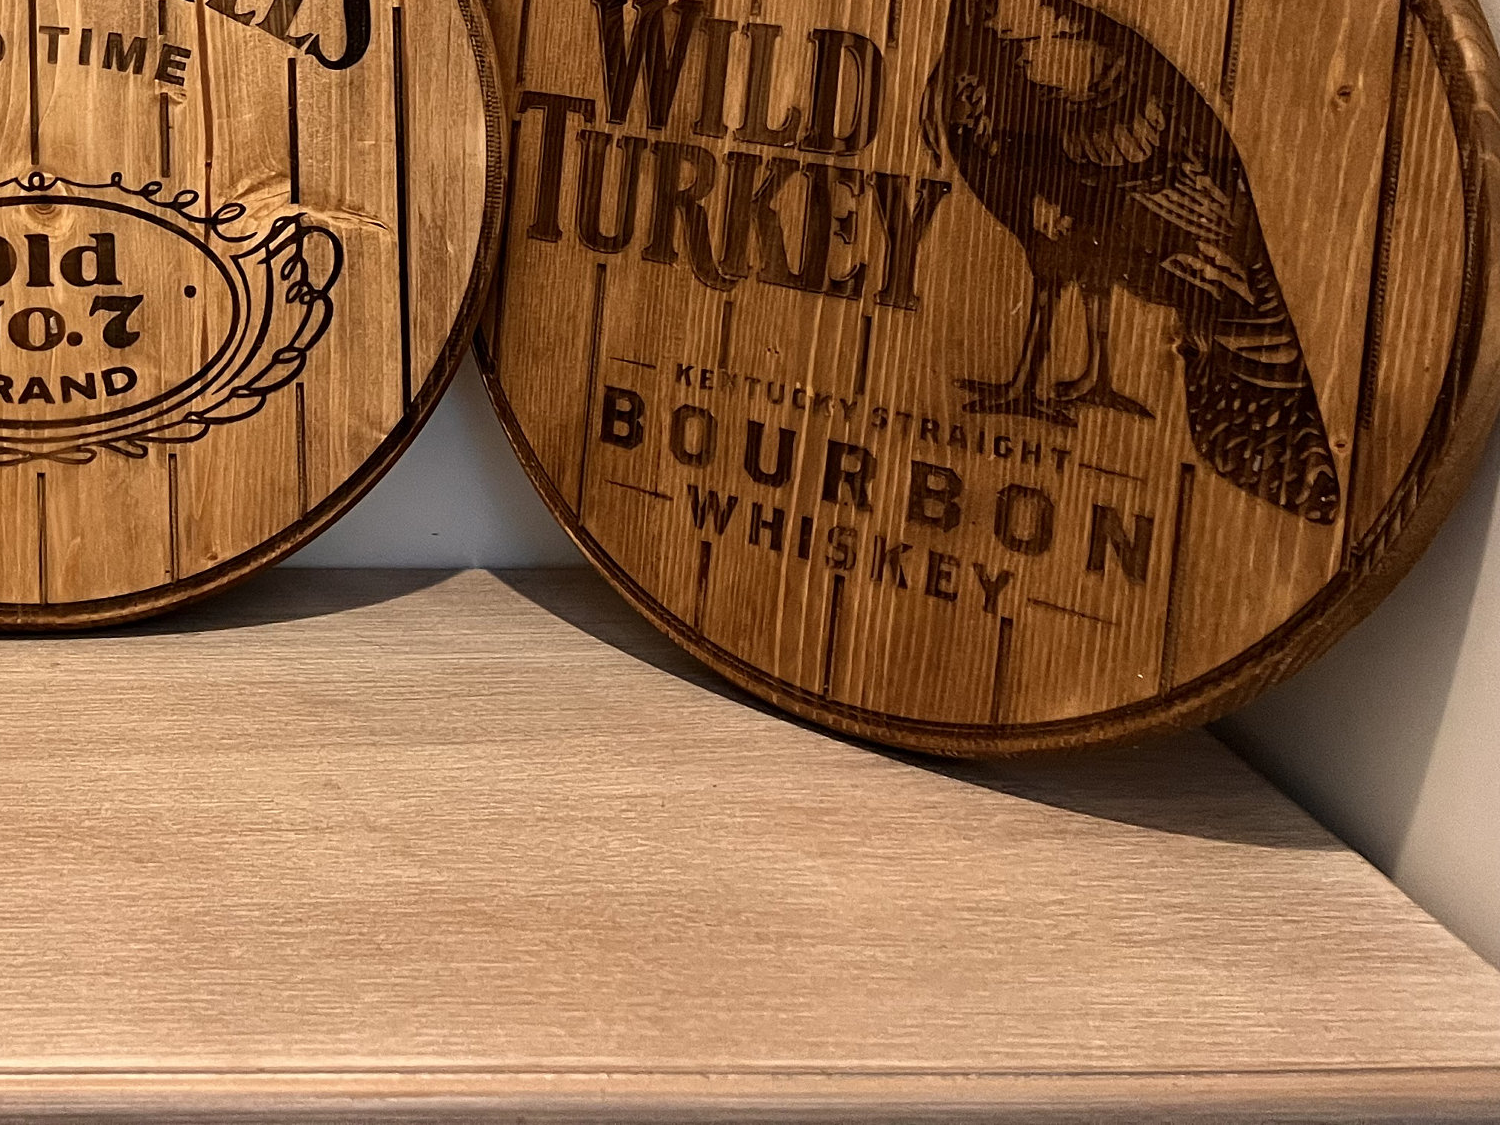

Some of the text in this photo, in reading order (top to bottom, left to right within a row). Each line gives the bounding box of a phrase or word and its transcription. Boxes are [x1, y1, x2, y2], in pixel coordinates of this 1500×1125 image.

[38, 26, 192, 88] TIME
[517, 91, 953, 311] TURKEY
[602, 386, 1156, 584] BOURBON
[676, 362, 1072, 475] KENTUCKY STRAIGHT
[687, 482, 1015, 617] WHISKEY
